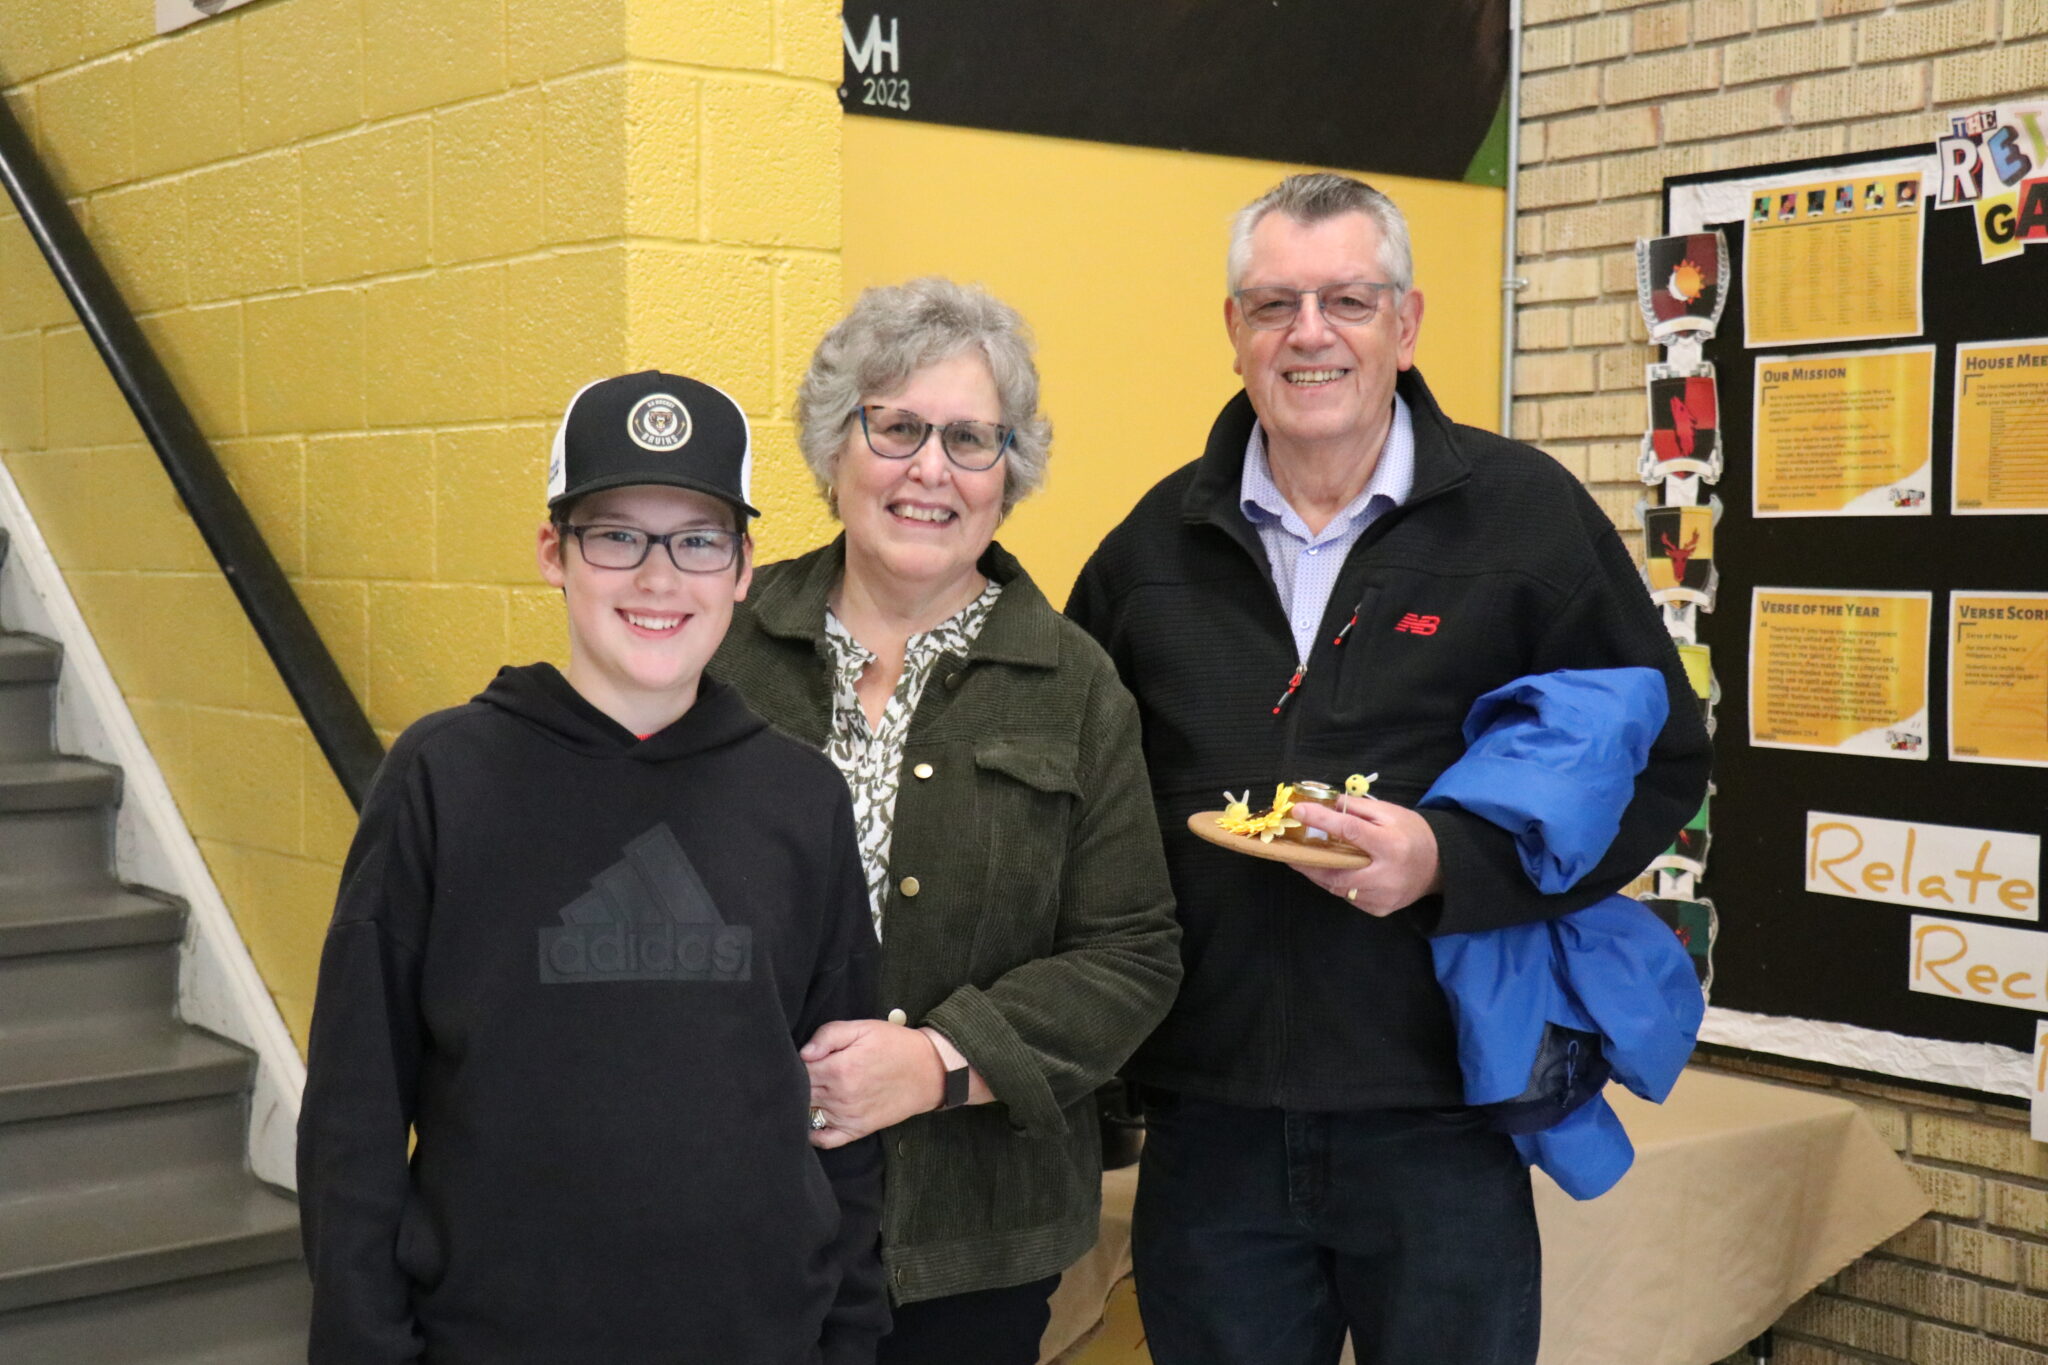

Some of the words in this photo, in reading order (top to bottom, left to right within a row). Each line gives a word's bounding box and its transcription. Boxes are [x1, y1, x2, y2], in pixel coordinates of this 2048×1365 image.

[862, 78, 911, 112] 2023
[1952, 110, 1998, 138] THE
[1984, 181, 2048, 244] GA
[1763, 370, 1789, 383] OUR
[1791, 368, 1847, 381] MISSION
[1965, 357, 2014, 371] HOUSE
[641, 432, 679, 446] BRUINS
[1760, 600, 1800, 614] VERSE
[1801, 604, 1818, 616] OF
[1820, 605, 1843, 616] THE
[1845, 603, 1880, 618] YEAR
[1959, 605, 2004, 620] VERSE
[1393, 612, 1441, 636] NB
[1810, 822, 2035, 911] Relate
[549, 922, 746, 976] adidas
[1915, 924, 2048, 1000] Rec
